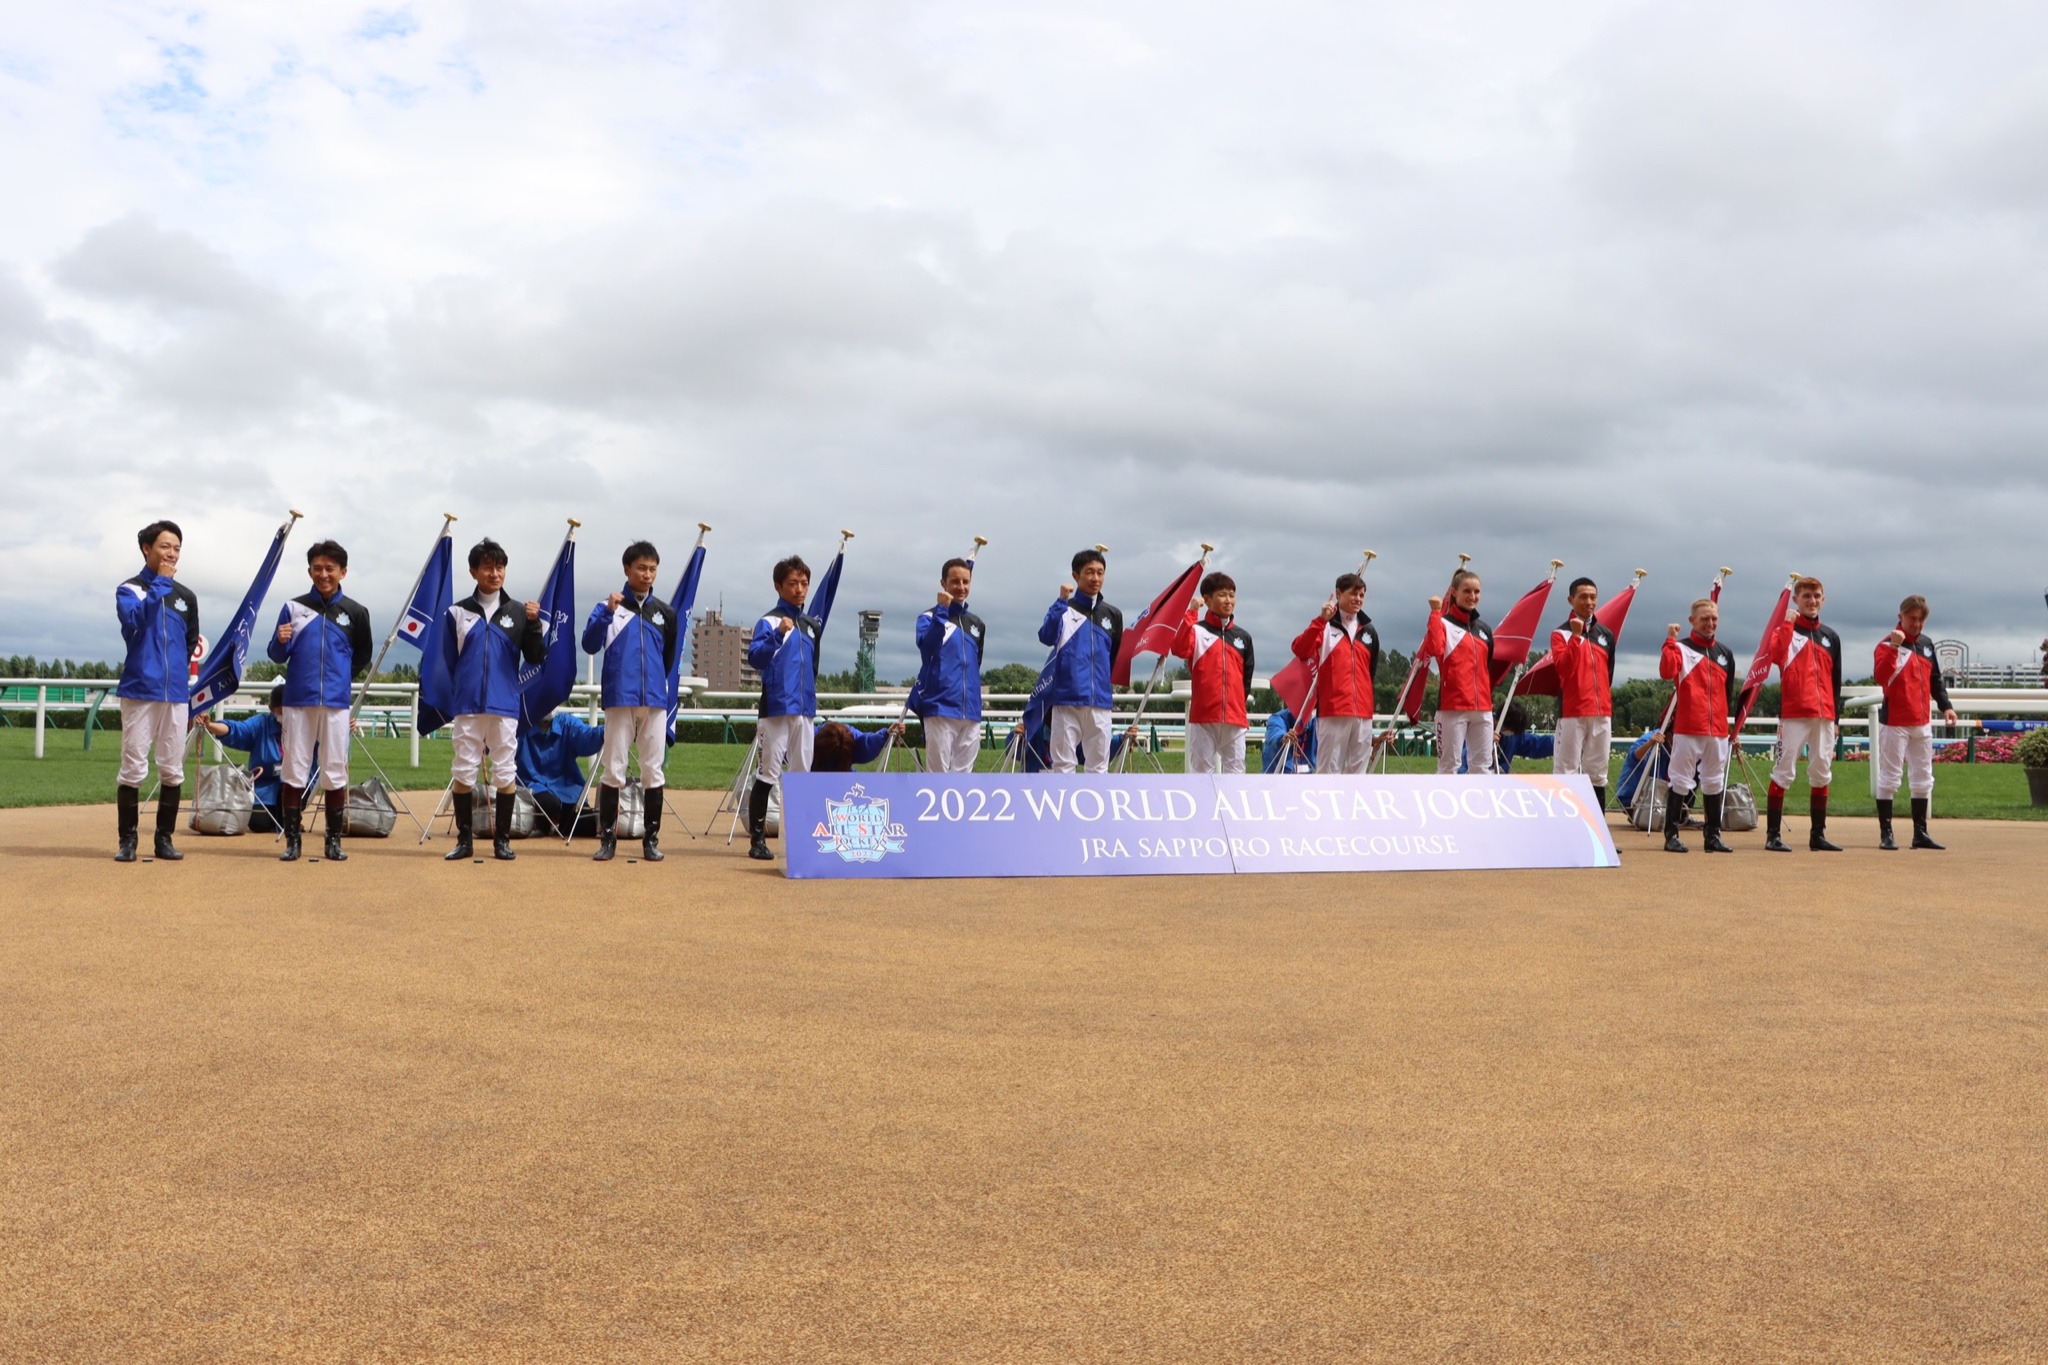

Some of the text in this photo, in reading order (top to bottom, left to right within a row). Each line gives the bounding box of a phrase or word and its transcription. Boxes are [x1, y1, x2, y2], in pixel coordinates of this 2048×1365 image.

[915, 788, 1580, 829] 2022 WORLD ALL-STAR JOCKEYS
[836, 814, 883, 822] WORLD
[813, 822, 906, 836] ALL STAR
[835, 836, 888, 846] JOCKEYS
[1081, 834, 1458, 863] JRA SAPPORO RACECOURSE
